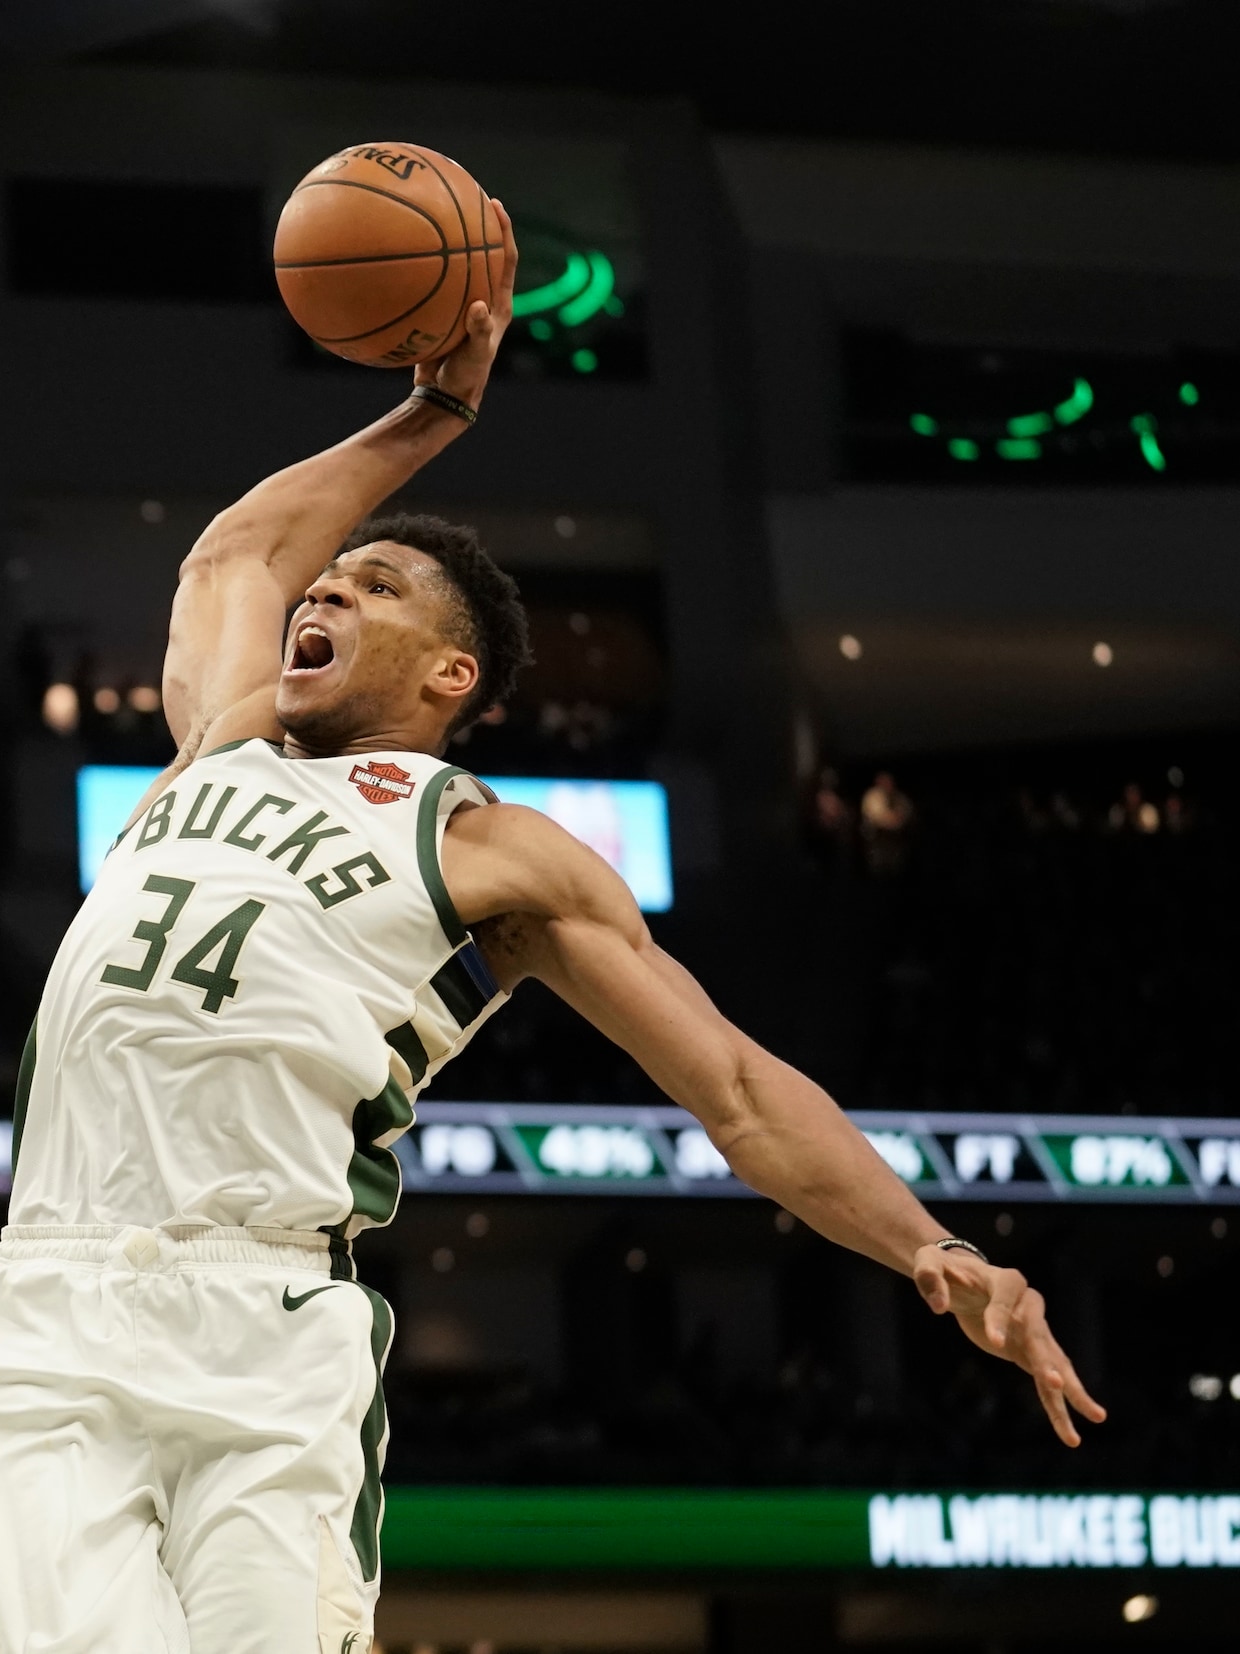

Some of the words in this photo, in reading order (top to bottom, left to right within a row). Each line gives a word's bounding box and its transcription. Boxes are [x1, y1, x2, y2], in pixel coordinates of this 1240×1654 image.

[354, 769, 412, 795] HARLEY-DAVIDSON
[362, 786, 394, 801] CYCLES
[372, 765, 404, 781] MOTOR
[133, 781, 393, 911] BUCKS
[97, 872, 269, 1016] 34
[868, 1494, 1147, 1569] MILWAUKEE
